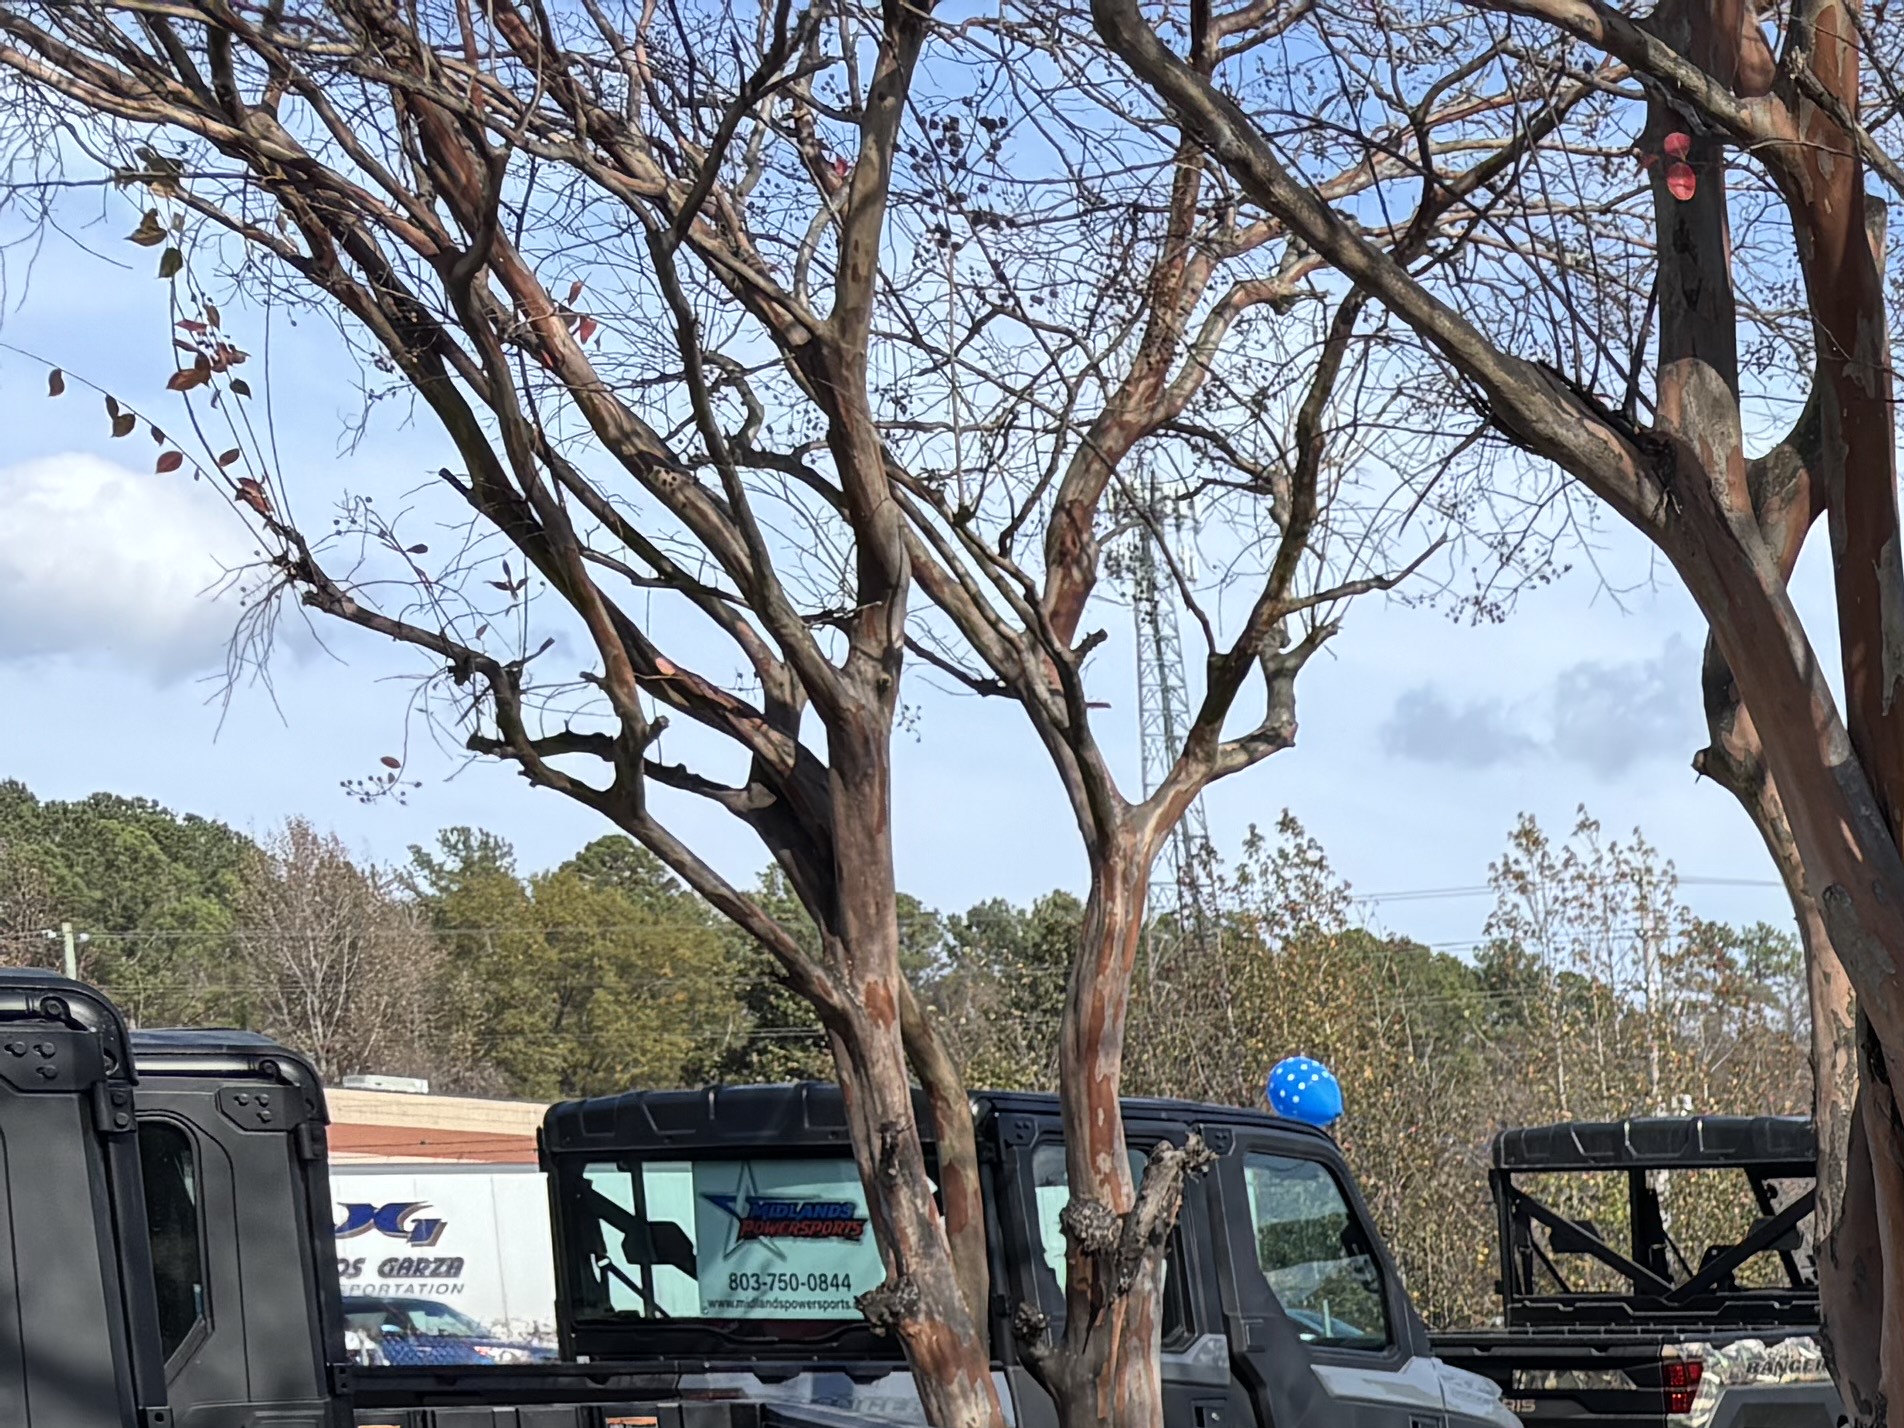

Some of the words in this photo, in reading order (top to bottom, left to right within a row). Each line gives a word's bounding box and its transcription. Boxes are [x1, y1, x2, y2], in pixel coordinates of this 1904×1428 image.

[751, 1203, 854, 1219] MIDLANDS
[740, 1220, 866, 1237] POWERSPORTS
[377, 1256, 465, 1278] GARZA
[728, 1272, 852, 1292] 803-750-0844
